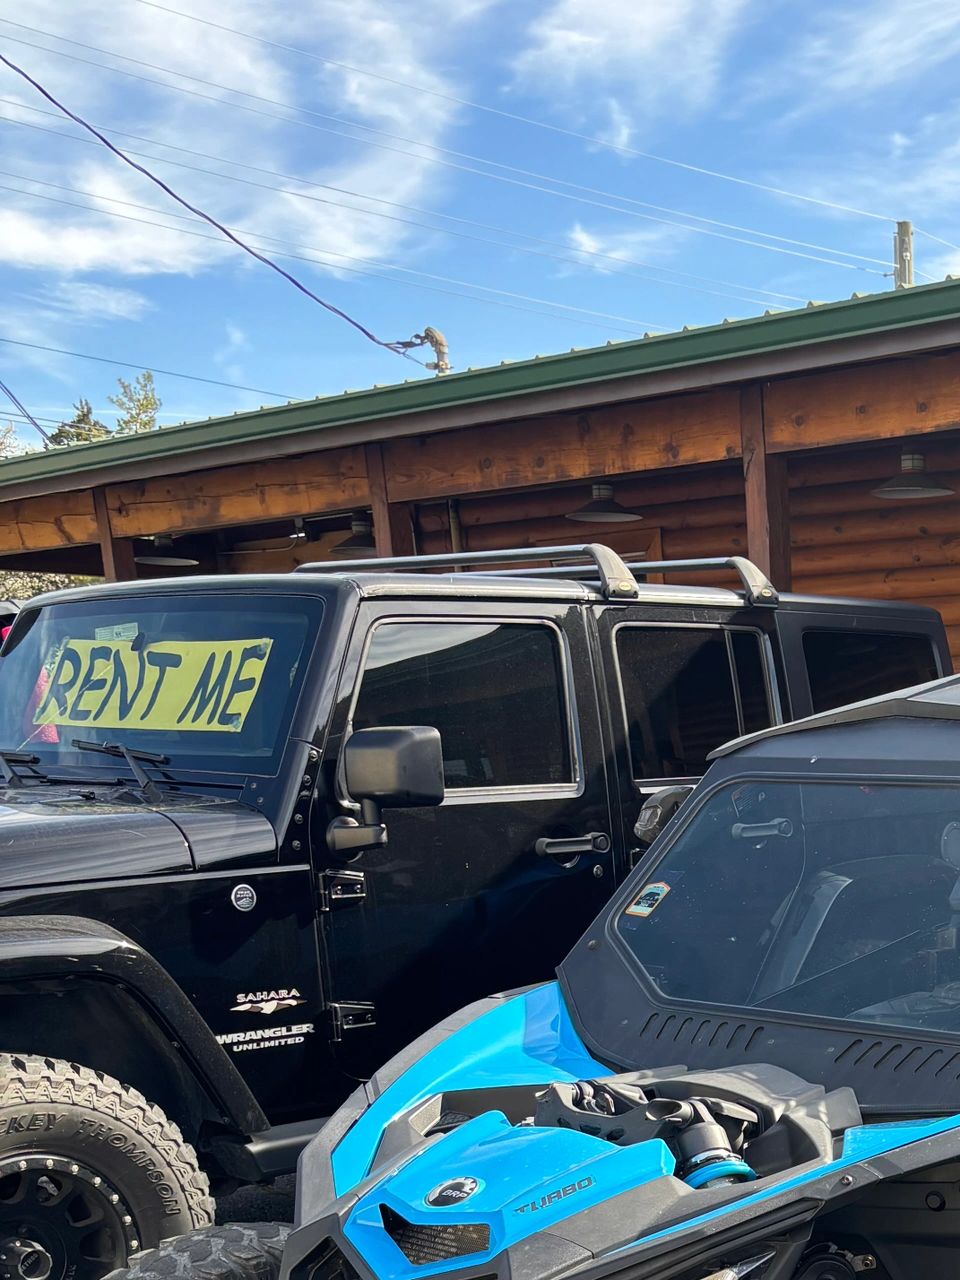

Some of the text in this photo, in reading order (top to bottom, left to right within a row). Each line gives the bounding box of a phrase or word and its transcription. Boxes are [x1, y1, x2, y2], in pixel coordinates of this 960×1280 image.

[38, 644, 267, 726] RENT ME
[236, 988, 301, 1003] SAHARA
[215, 1022, 316, 1045] WRANGLER
[232, 1036, 305, 1052] UNLIMITED
[76, 1117, 182, 1217] THOMPSON
[441, 1189, 469, 1199] BRP
[514, 1175, 596, 1214] TURBO
